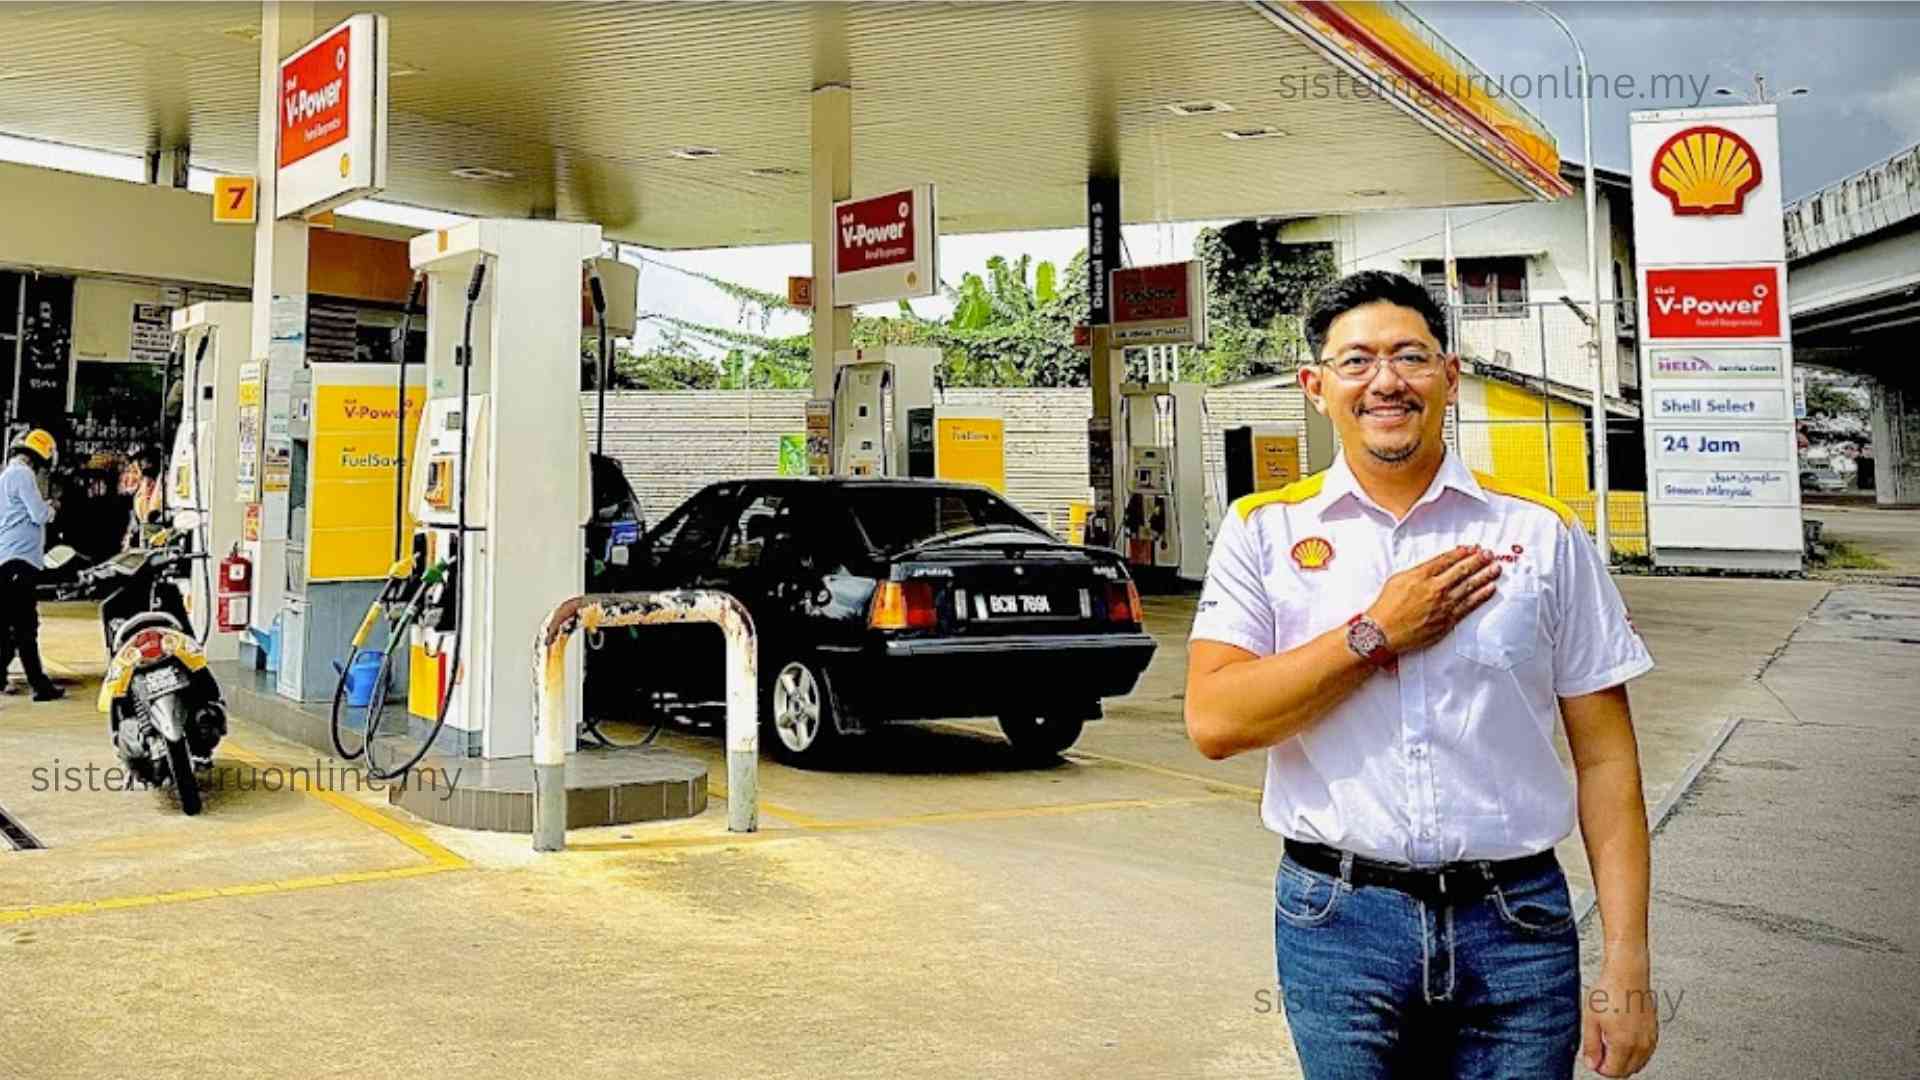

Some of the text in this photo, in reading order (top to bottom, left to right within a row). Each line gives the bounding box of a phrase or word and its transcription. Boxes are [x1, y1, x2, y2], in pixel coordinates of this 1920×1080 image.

[286, 78, 342, 128] V-Power
[228, 187, 246, 209] 7
[842, 221, 906, 249] V-Power
[1092, 259, 1104, 309] Diesel
[1655, 296, 1763, 316] V-Power
[1661, 399, 1755, 413] Shell Select
[1663, 435, 1741, 453] 24 Jam
